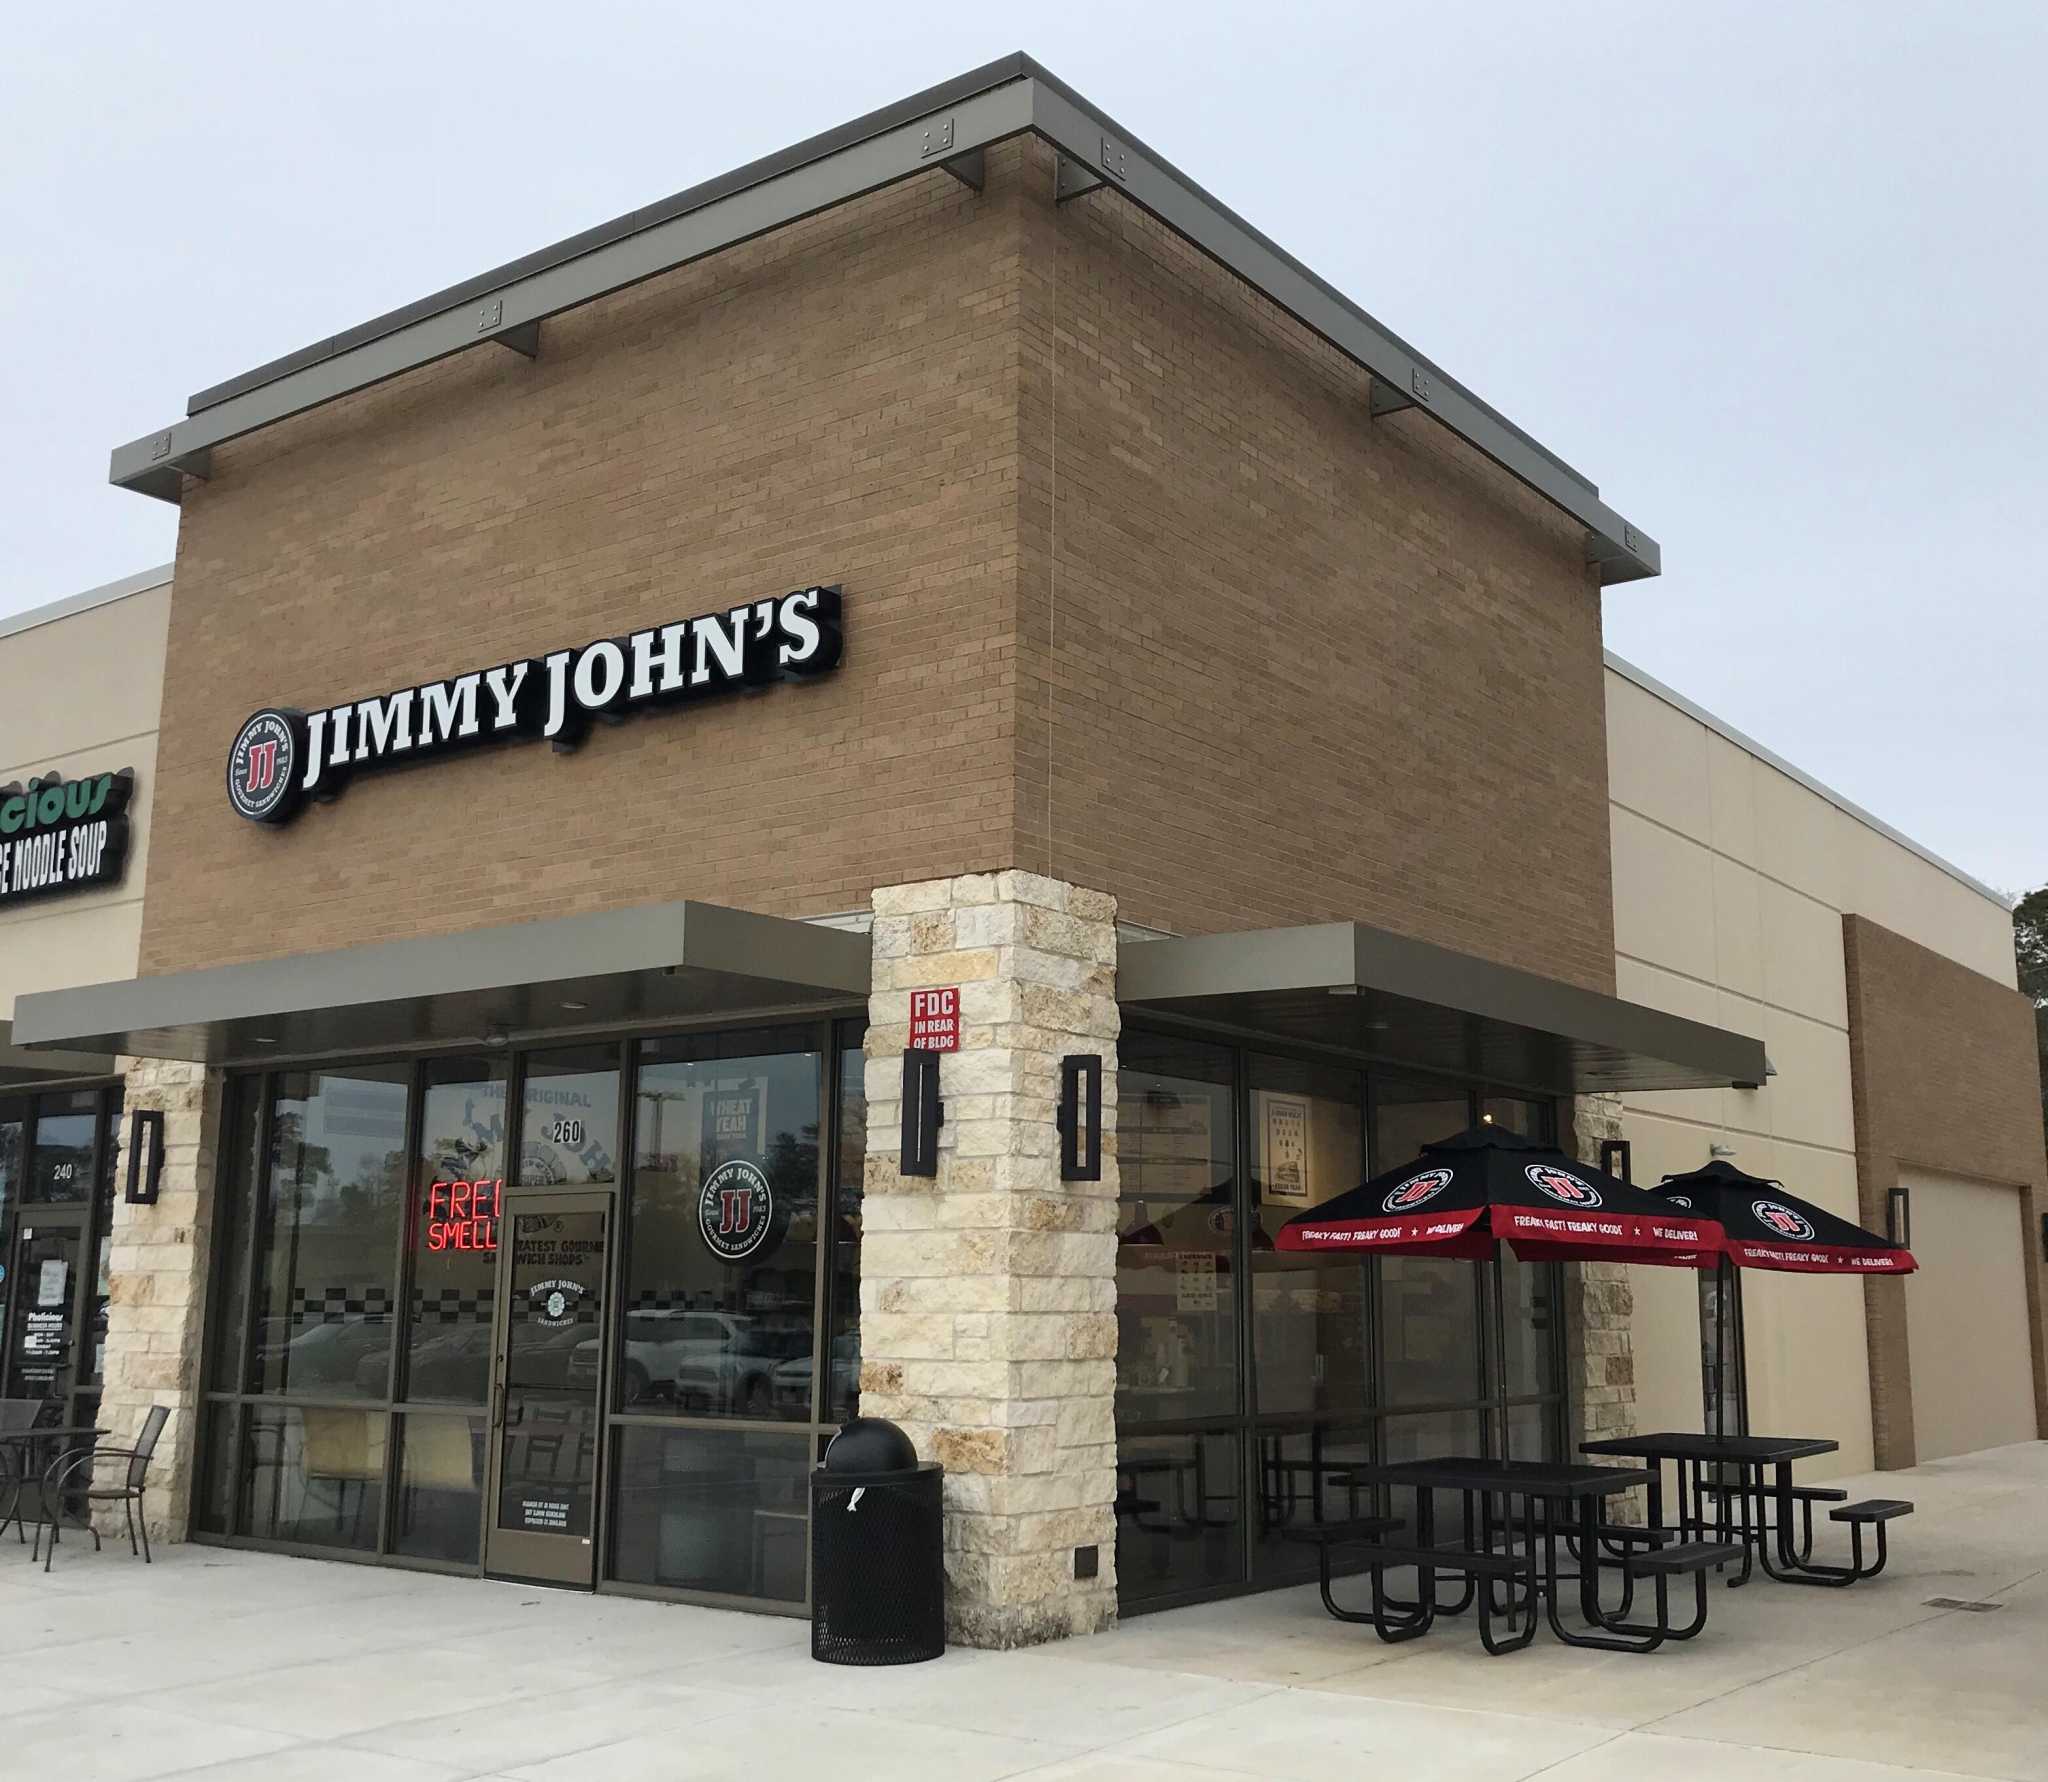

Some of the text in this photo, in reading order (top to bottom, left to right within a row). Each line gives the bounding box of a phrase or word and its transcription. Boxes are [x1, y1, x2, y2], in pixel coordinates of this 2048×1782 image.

[302, 590, 820, 789] JIMMY JOHN'S
[236, 721, 263, 764] JIMMY
[246, 739, 278, 793] JJ
[0, 820, 107, 894] E NOODLE SOUP
[914, 990, 954, 1017] FDC
[914, 1020, 954, 1034] IN REAR
[913, 1035, 954, 1049] OF BLDG
[523, 1087, 592, 1109] RIGINAL
[553, 1120, 581, 1143] 260
[54, 1163, 73, 1180] 240
[705, 1167, 767, 1206] JIMMY JOHN'S
[720, 1188, 752, 1233] JJ
[1567, 1220, 1598, 1233] FREAKY
[530, 1280, 557, 1297] JIMMY
